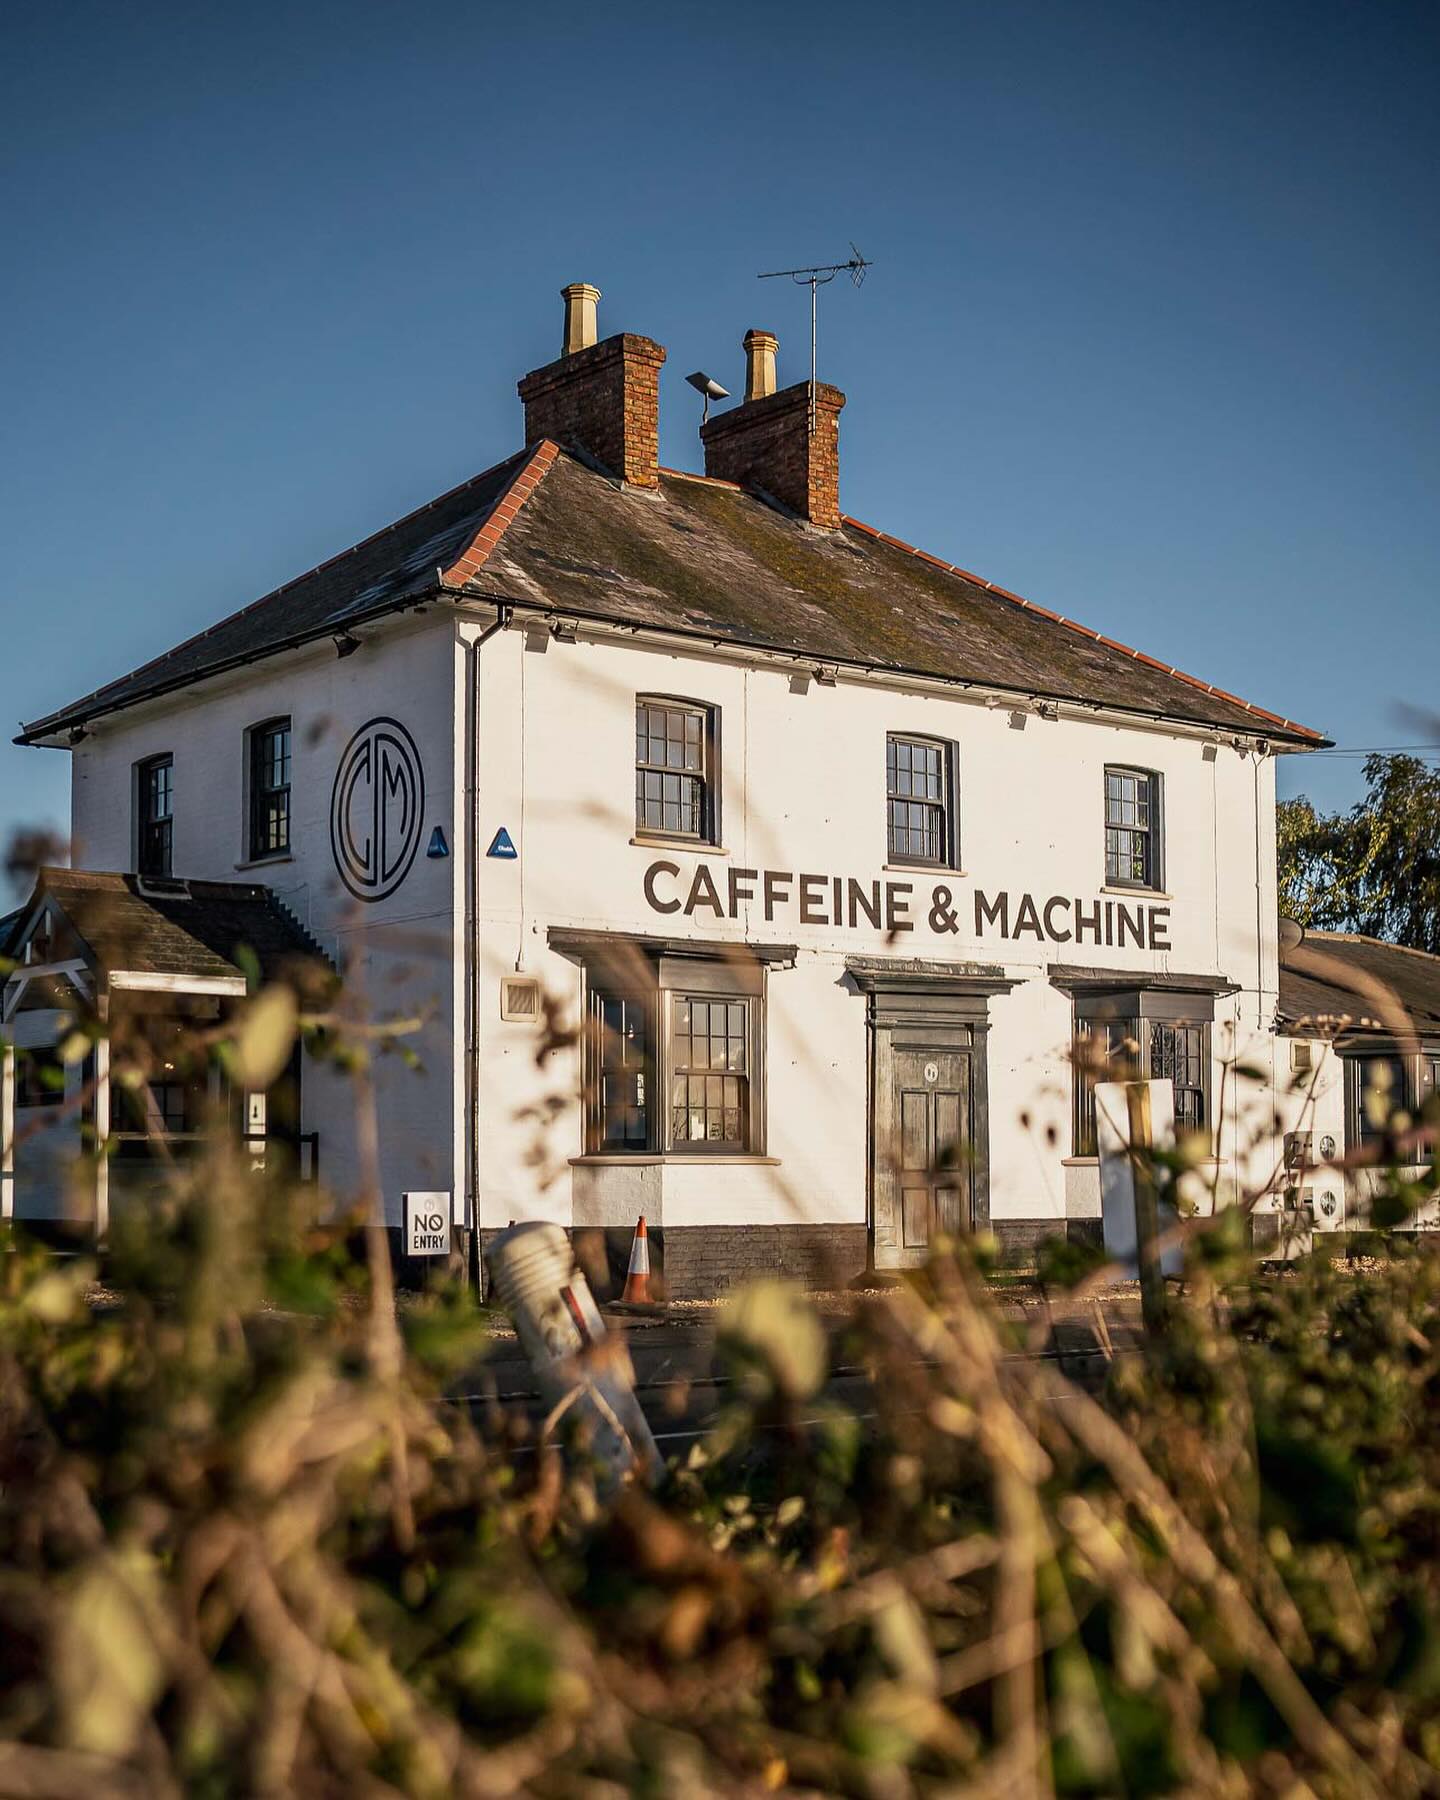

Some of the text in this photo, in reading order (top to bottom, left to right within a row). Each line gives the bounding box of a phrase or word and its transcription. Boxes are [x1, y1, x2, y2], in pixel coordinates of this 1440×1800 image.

[643, 860, 1172, 951] CAFFEINE & MACHINE
[414, 1213, 443, 1232] NO
[413, 1234, 444, 1249] ENTRY
